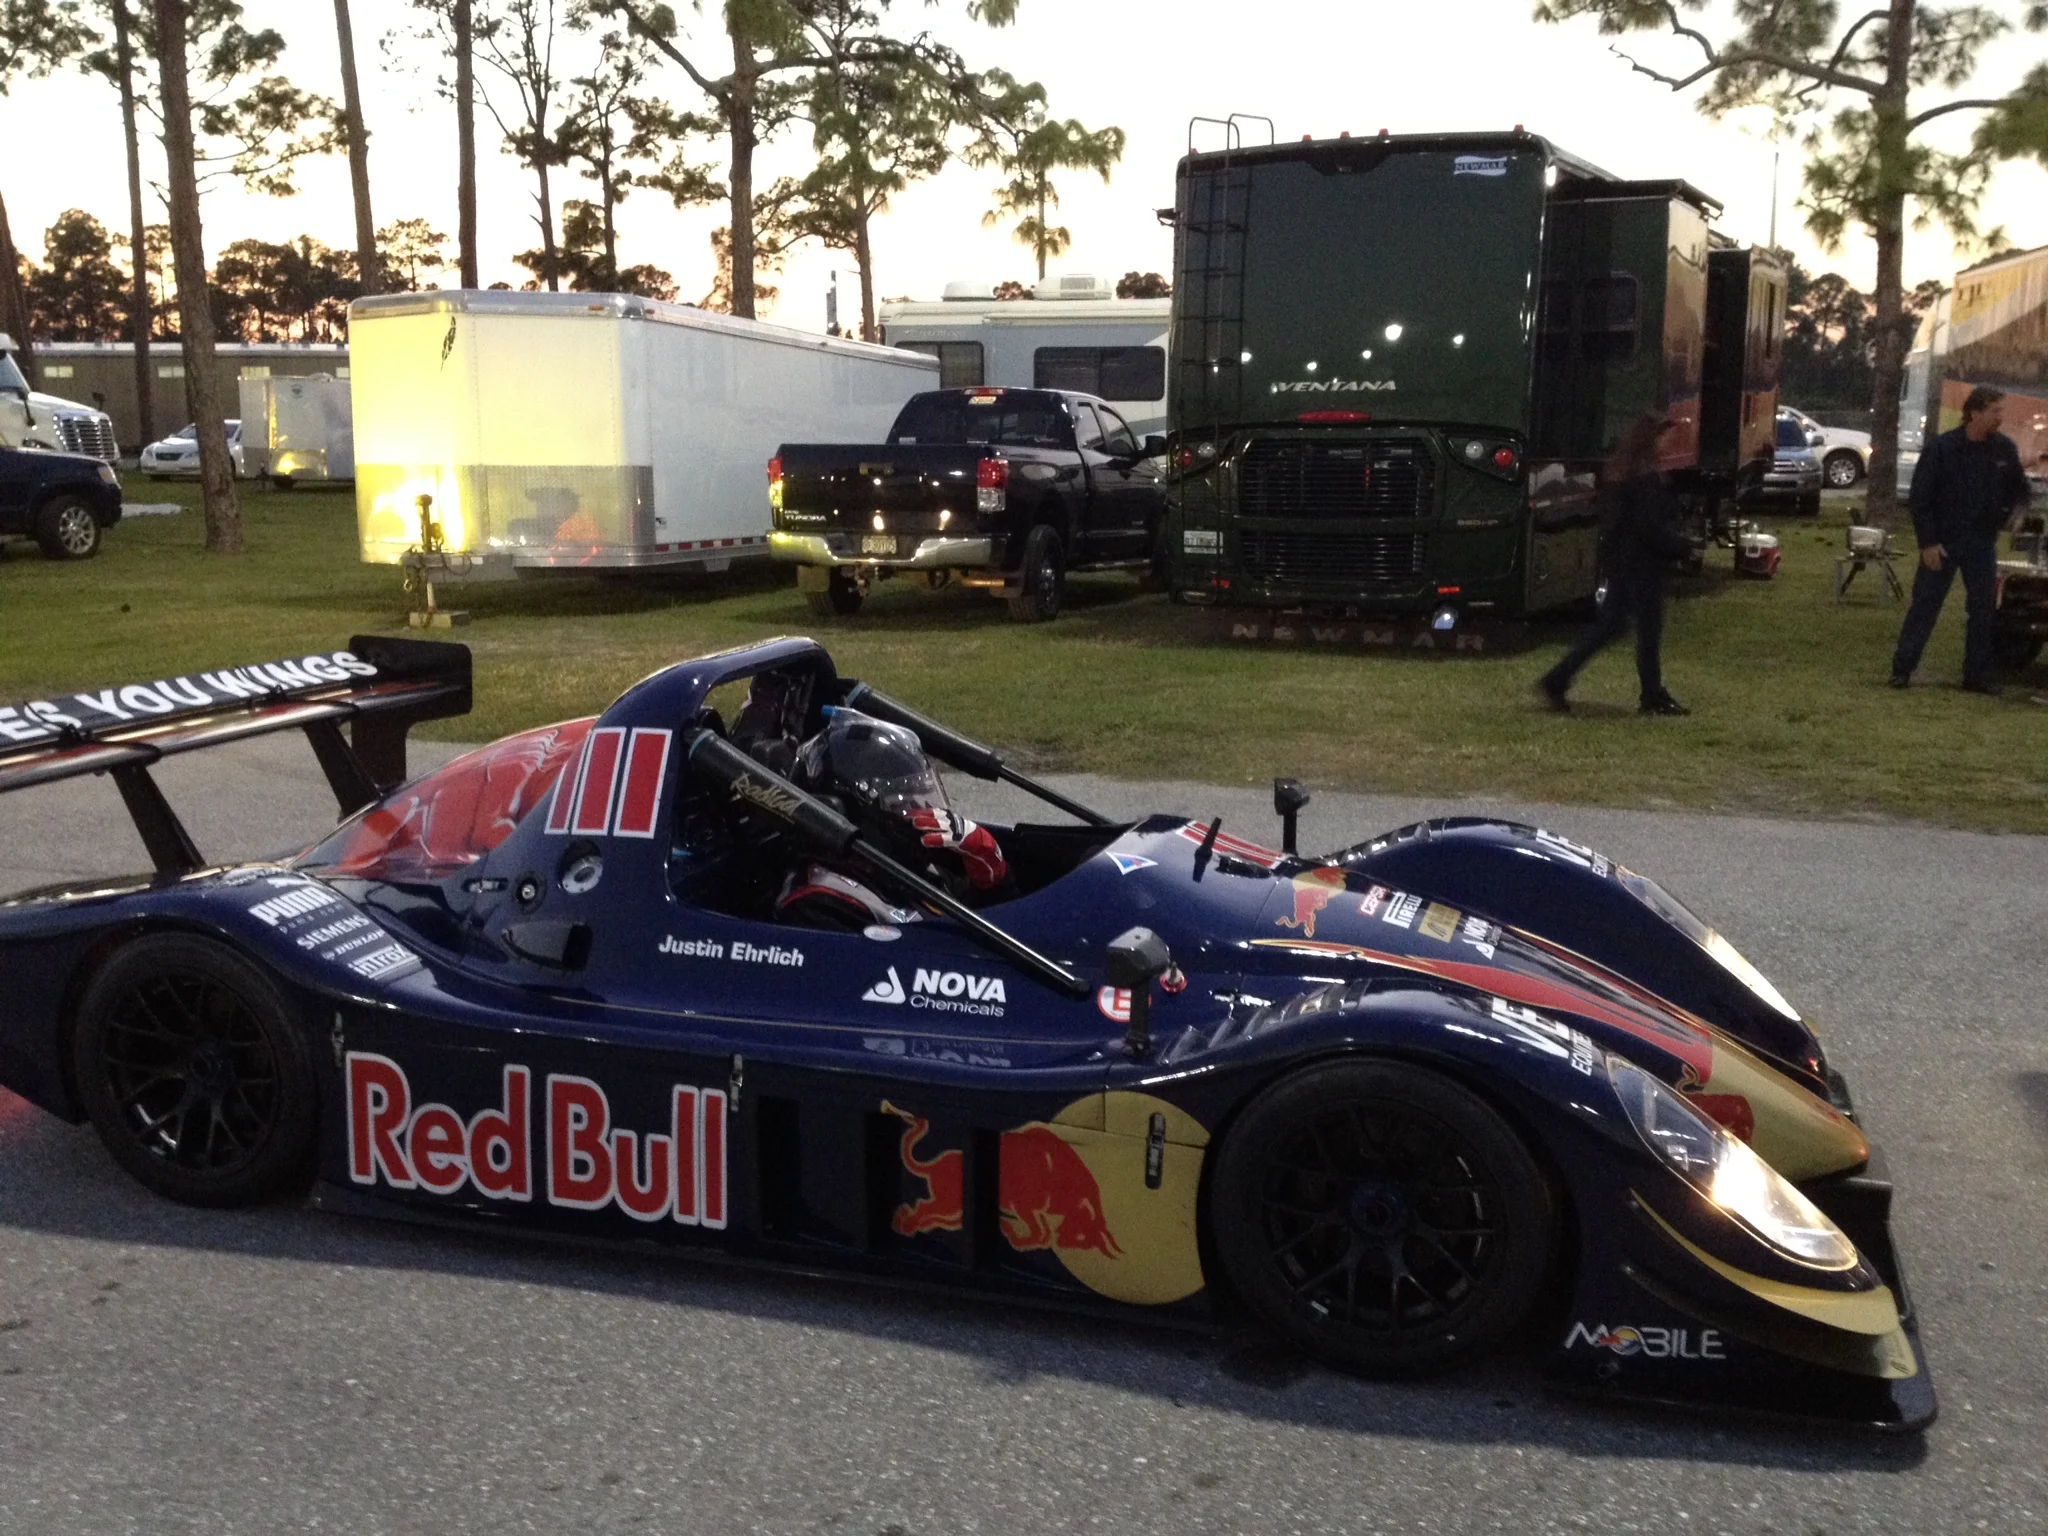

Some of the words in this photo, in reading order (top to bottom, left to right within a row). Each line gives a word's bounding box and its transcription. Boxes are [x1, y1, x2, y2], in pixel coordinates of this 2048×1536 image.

[1277, 380, 1396, 392] VENTANA
[75, 677, 213, 720] YOU
[200, 651, 378, 697] WINGS
[248, 886, 337, 927] PUMA
[295, 914, 371, 951] SIEMENS
[333, 927, 387, 956] DUNLOP
[658, 934, 725, 960] Justin
[731, 940, 805, 968] Ehrlich
[911, 968, 1007, 1003] NOVA
[910, 994, 1006, 1017] Chemicals
[346, 1051, 533, 1204] Red
[547, 1074, 728, 1231] Bull
